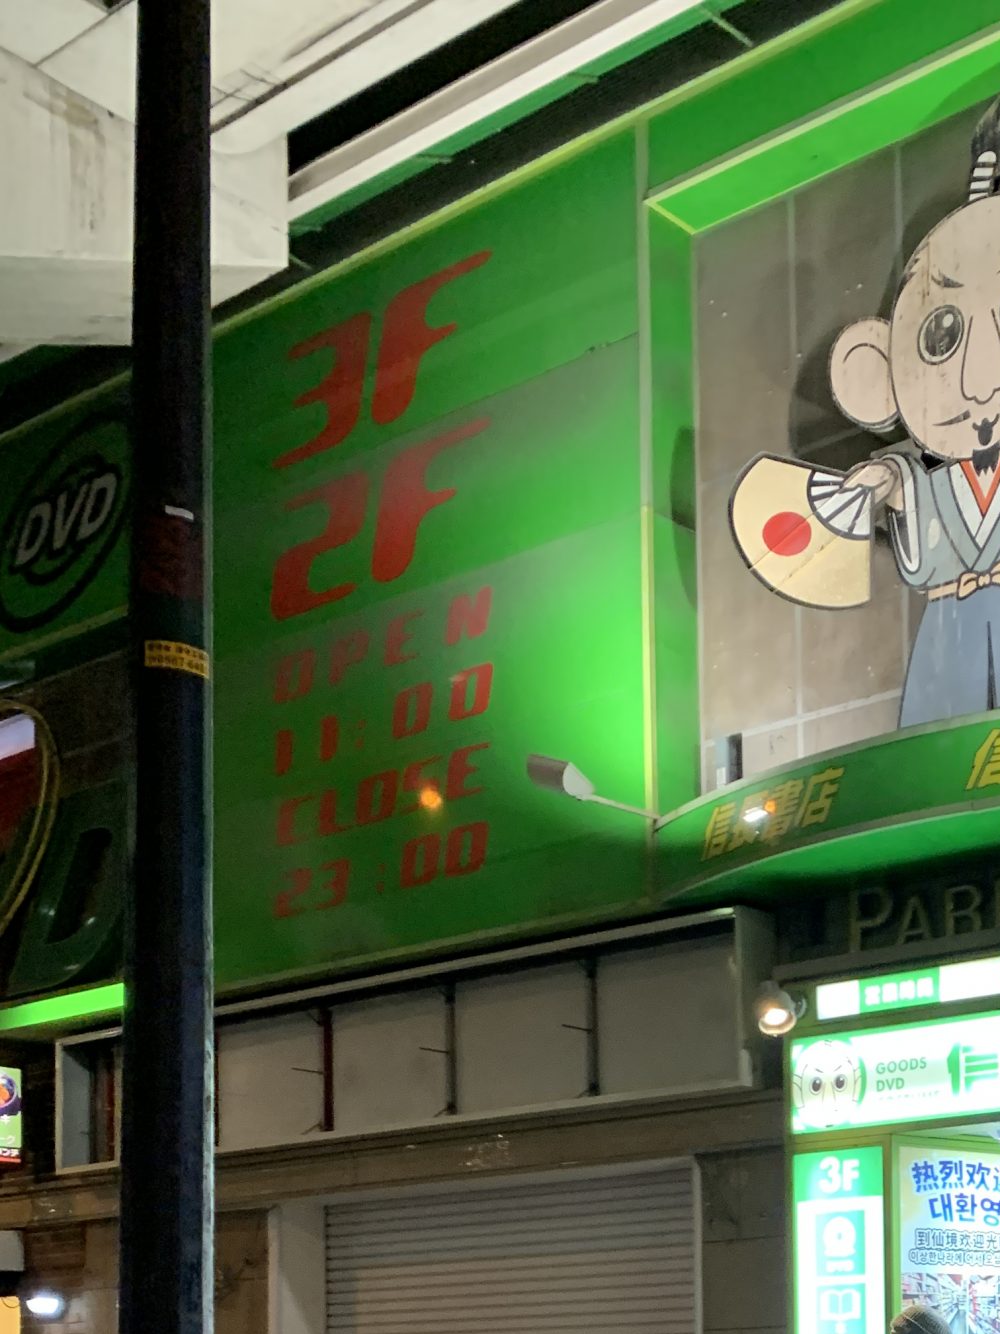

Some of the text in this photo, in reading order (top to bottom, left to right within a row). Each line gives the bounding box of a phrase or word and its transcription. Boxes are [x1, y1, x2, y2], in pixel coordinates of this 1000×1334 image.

[272, 249, 493, 468] 3F
[15, 472, 117, 566] DVD
[270, 417, 492, 621] 2F
[273, 586, 493, 704] OPEN
[275, 661, 494, 777] 11:00
[276, 742, 491, 846] CLOSE
[273, 820, 489, 918] 23:00
[875, 1057, 928, 1076] GOODS
[875, 1078, 905, 1093] DVD
[819, 1156, 860, 1194] 3F
